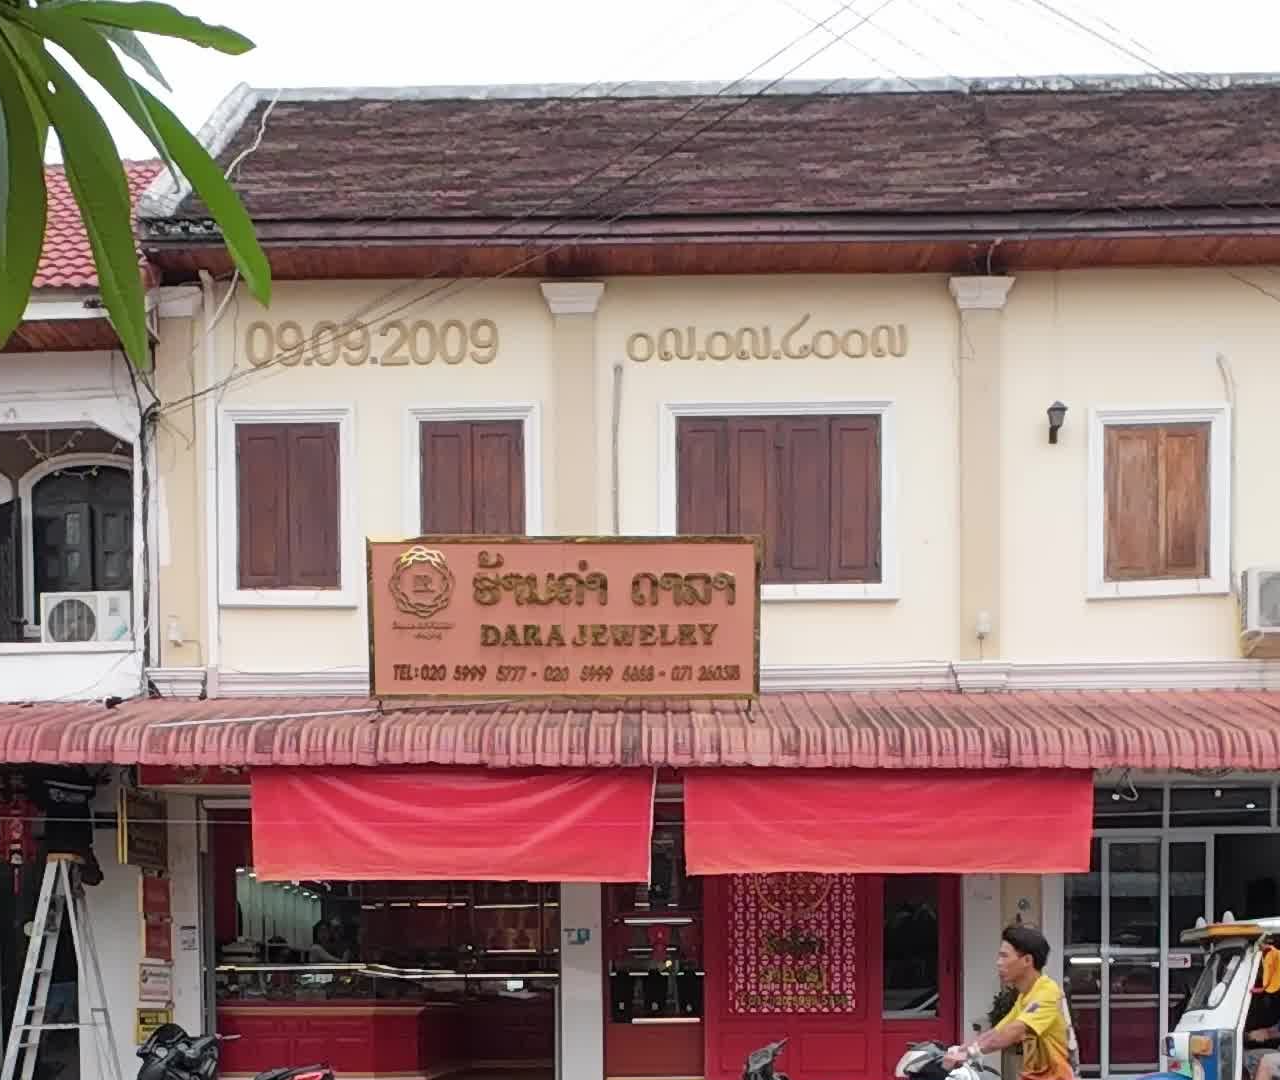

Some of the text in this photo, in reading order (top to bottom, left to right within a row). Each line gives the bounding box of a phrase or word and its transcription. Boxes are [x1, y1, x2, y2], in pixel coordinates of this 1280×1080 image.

[244, 319, 499, 369] 09.09.2009
[480, 624, 719, 647] DARA JEWELRY
